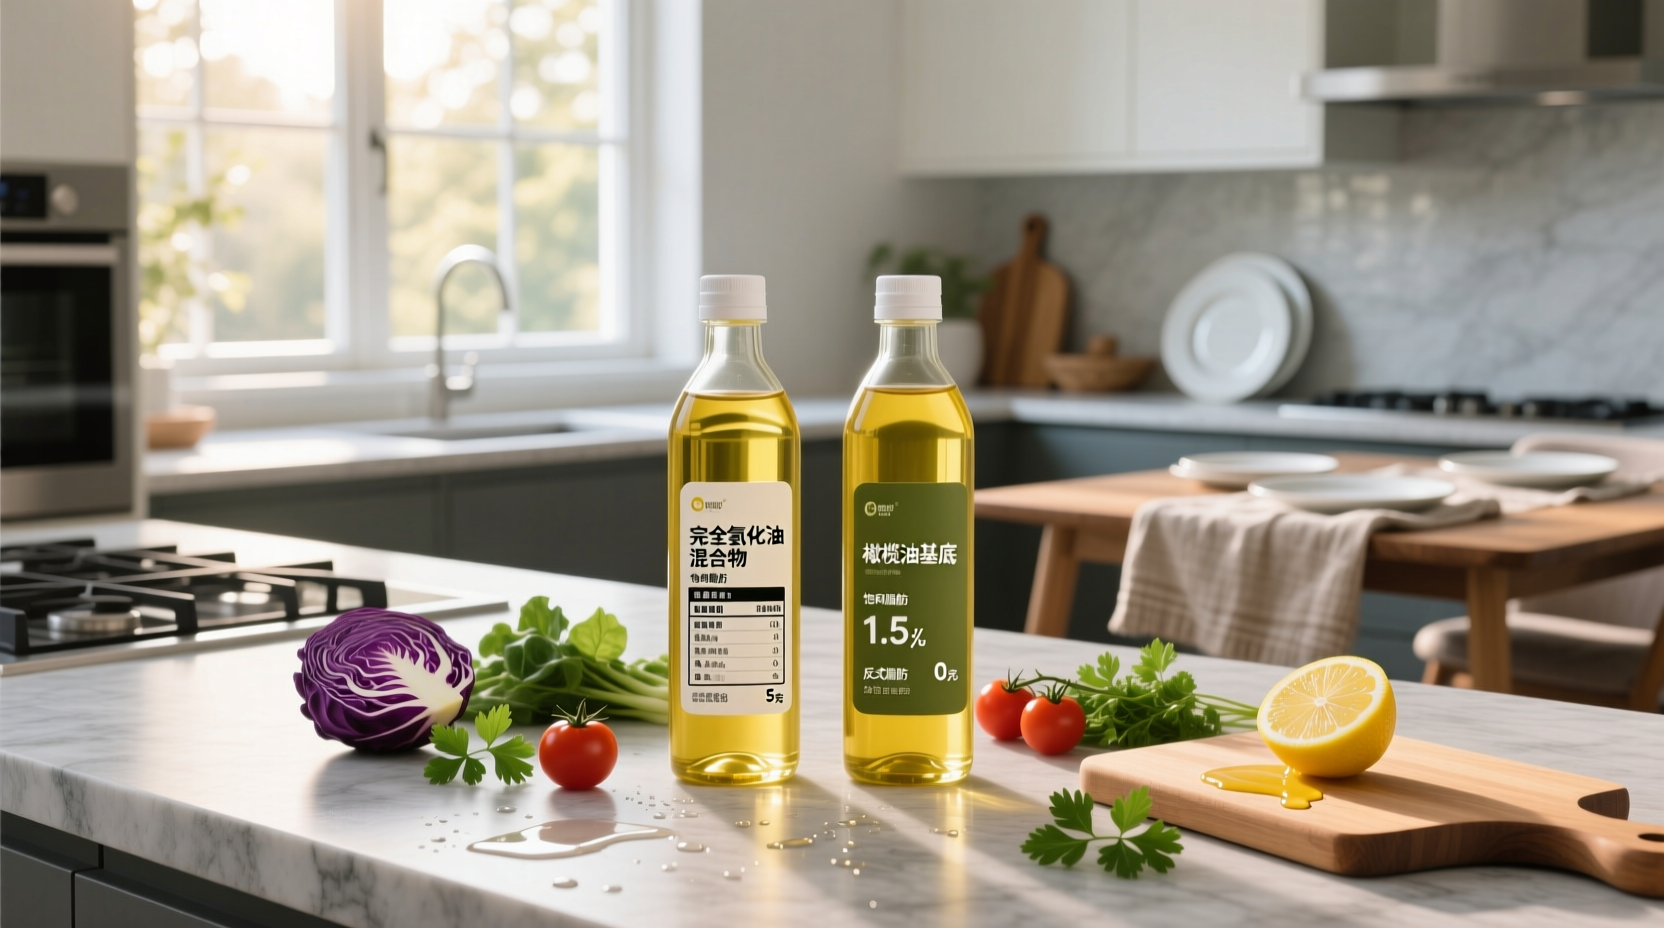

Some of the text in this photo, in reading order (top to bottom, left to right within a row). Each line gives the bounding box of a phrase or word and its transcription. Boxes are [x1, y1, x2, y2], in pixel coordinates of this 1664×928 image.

[689, 548, 747, 568] 混合物
[862, 542, 958, 565] 橄榄油基底
